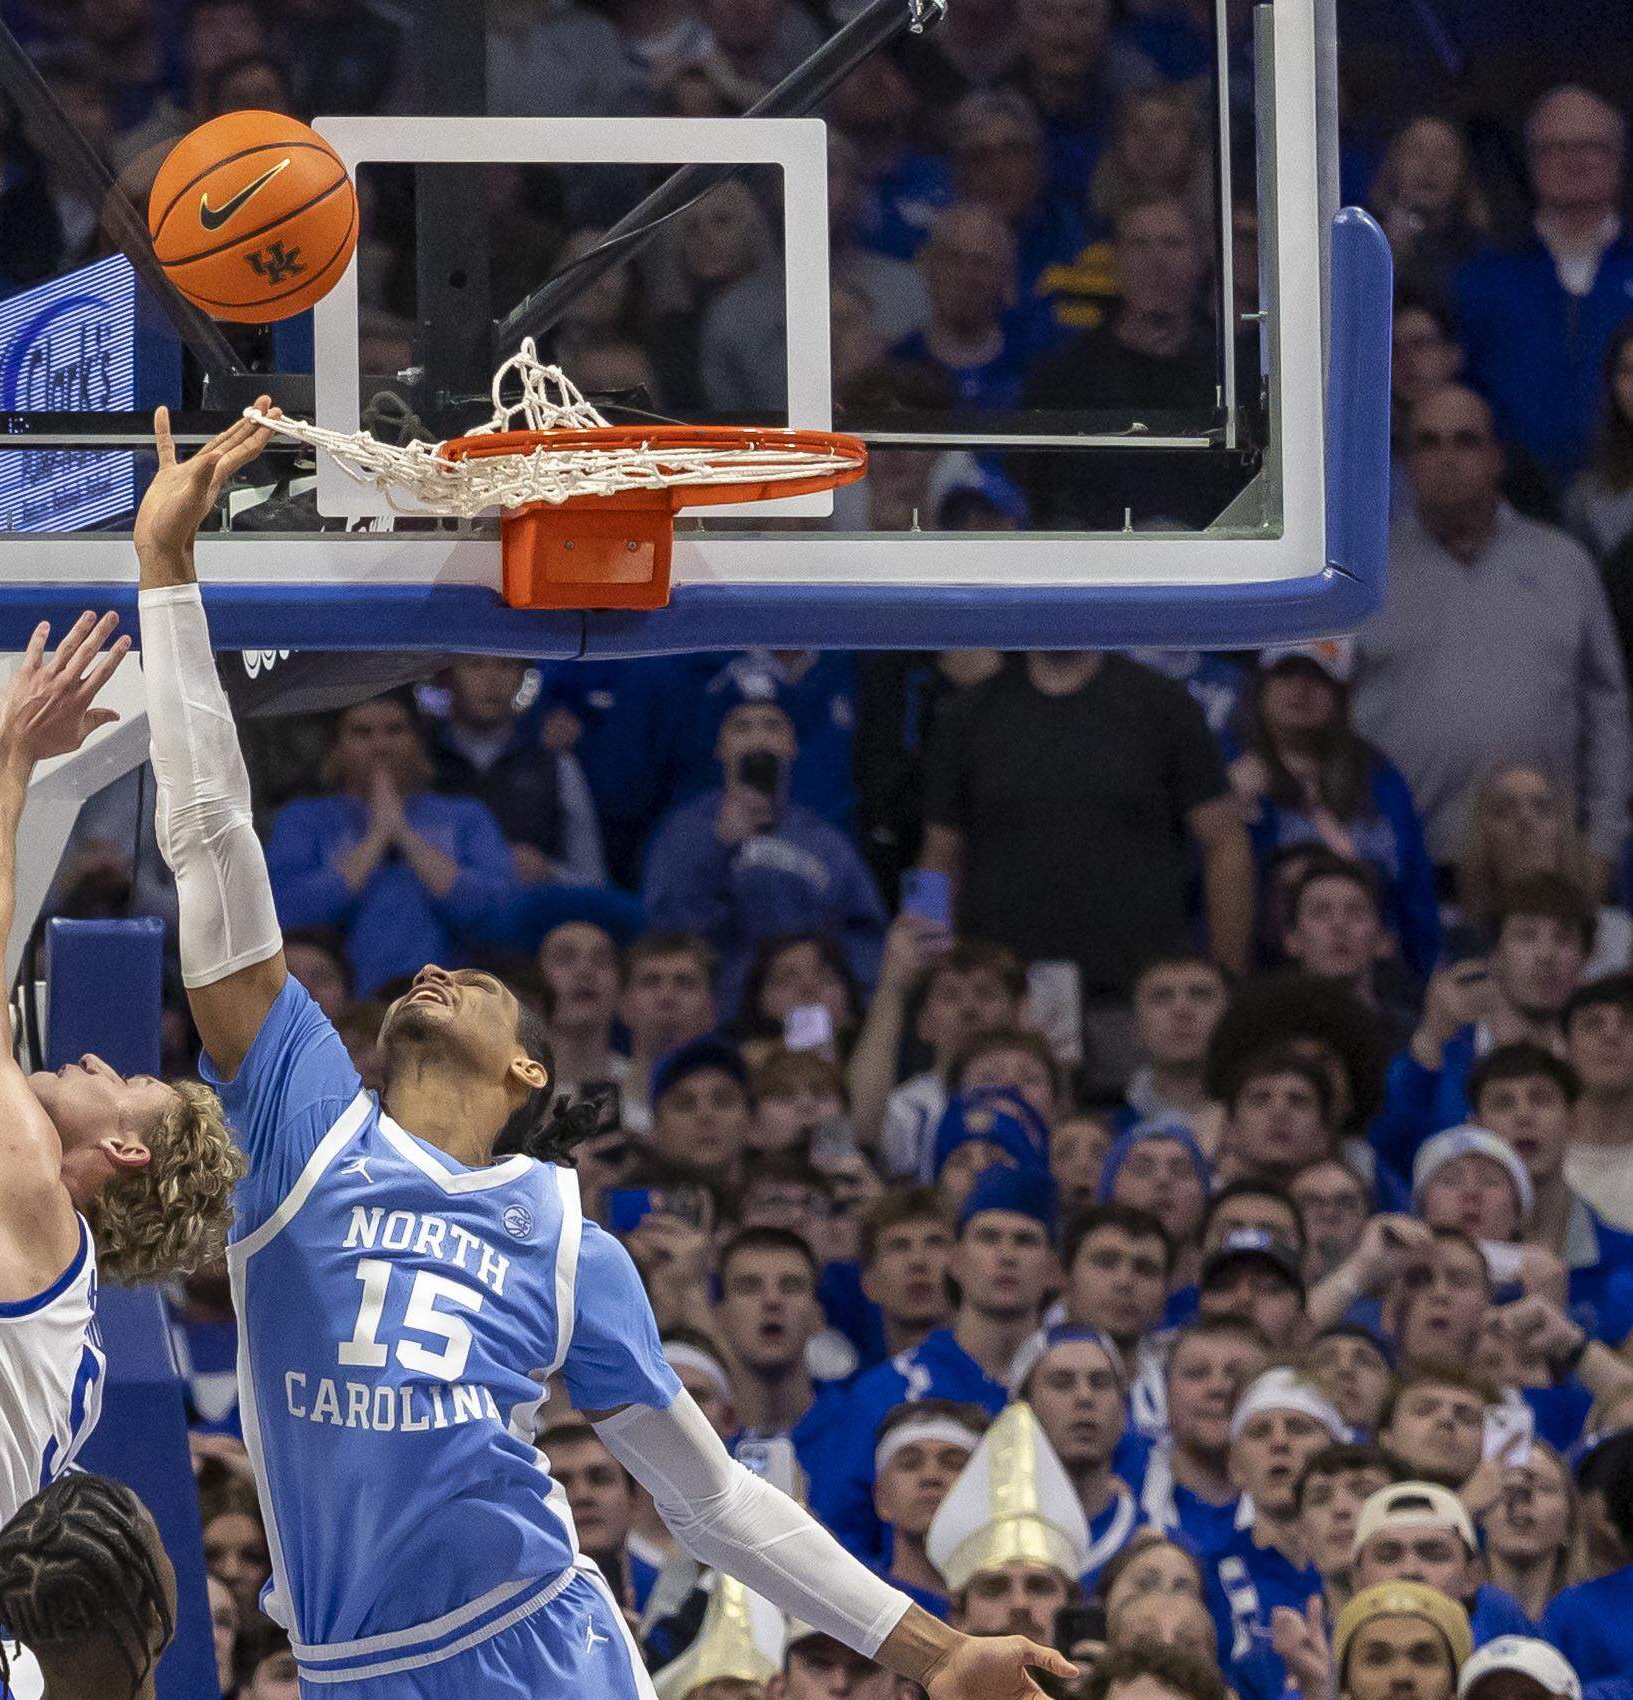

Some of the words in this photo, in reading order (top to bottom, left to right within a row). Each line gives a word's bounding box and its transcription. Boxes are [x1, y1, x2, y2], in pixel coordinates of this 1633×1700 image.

[243, 240, 308, 286] UK
[342, 1205, 511, 1297] NORTH
[338, 1258, 484, 1382] 15
